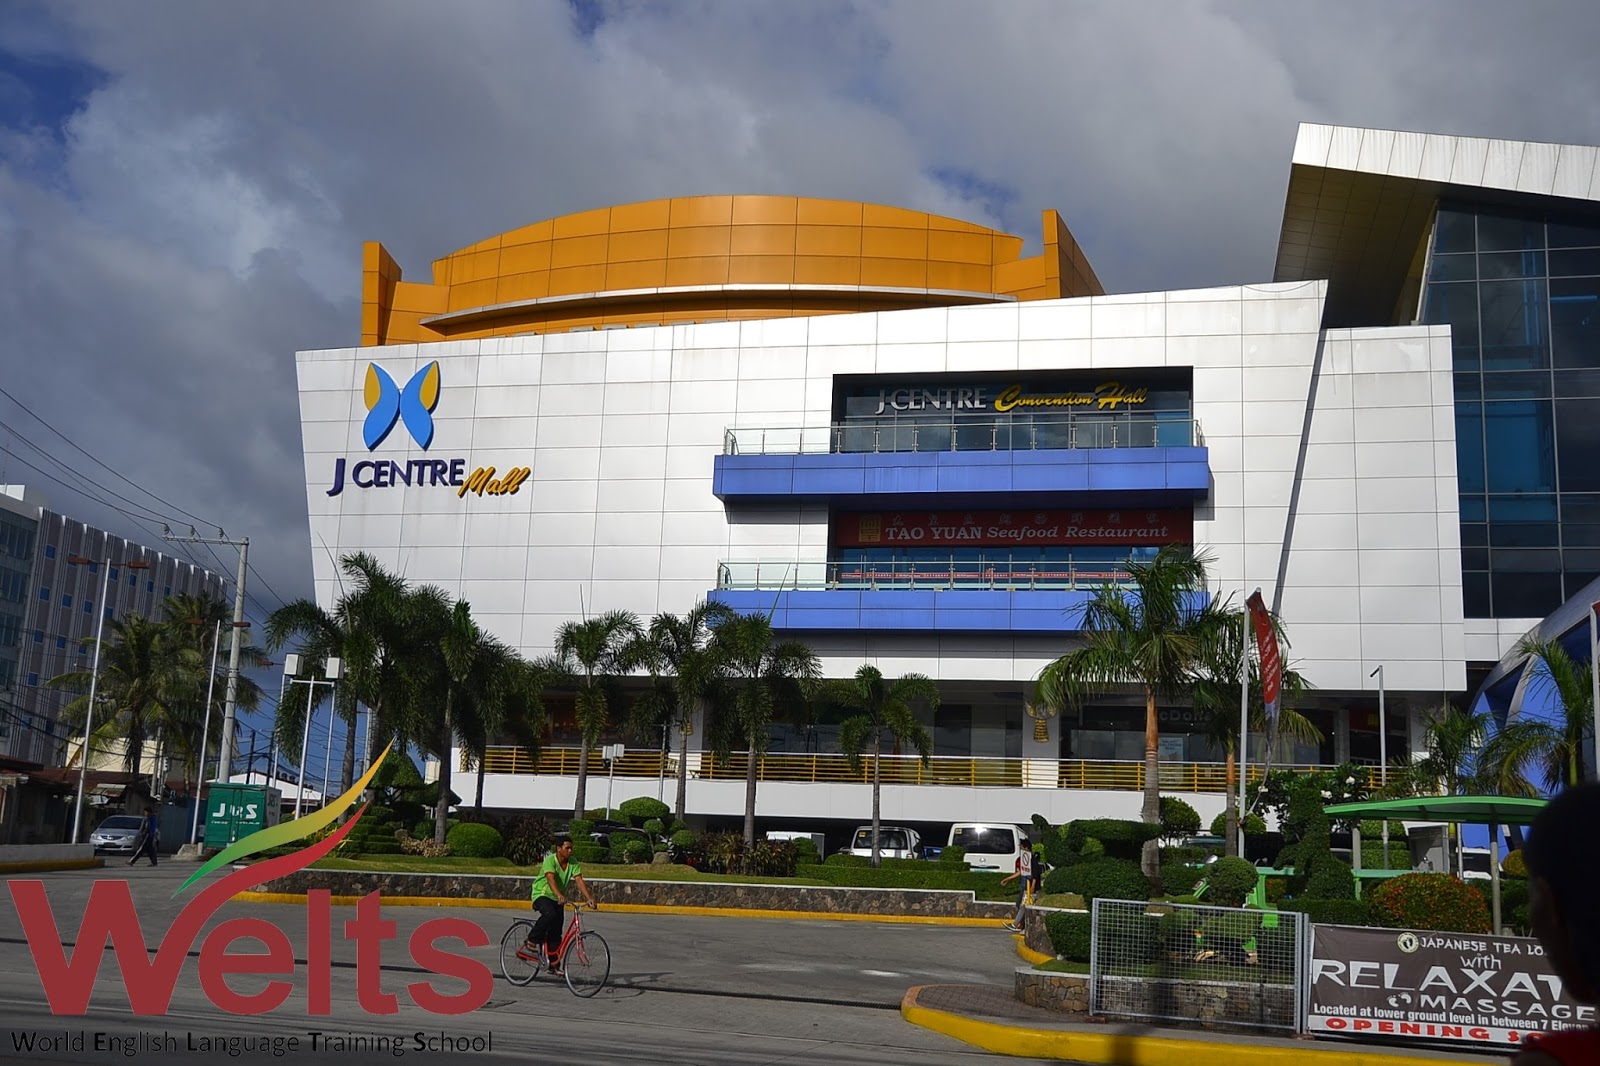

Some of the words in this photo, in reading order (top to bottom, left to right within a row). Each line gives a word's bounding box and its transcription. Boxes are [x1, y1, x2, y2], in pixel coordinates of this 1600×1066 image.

[876, 388, 886, 415] J
[890, 387, 987, 411] CENTRE
[994, 382, 1093, 412] Convention
[1094, 380, 1148, 411] Hall
[326, 458, 346, 497] J
[352, 458, 466, 488] CENTRE
[457, 466, 531, 498] Mall
[885, 526, 925, 541] TAO
[930, 526, 983, 540] YUAN
[986, 526, 1059, 541] Seafood
[1064, 525, 1169, 538] Restaurant
[1420, 936, 1488, 952] JAPANESE
[1492, 941, 1522, 955] TEA
[1526, 943, 1548, 957] LO
[1460, 953, 1502, 970] with
[1312, 958, 1563, 1002] RELAXAT
[1313, 1002, 1357, 1016] Located
[1360, 1006, 1371, 1018] at
[1374, 1006, 1405, 1020] lower
[1408, 1010, 1446, 1023] ground
[1449, 1011, 1475, 1025] level
[1478, 1014, 1489, 1026] in
[1491, 1015, 1538, 1030] between
[1540, 1019, 1549, 1031] 7
[1420, 994, 1596, 1022] MASSAGE
[1325, 1018, 1490, 1040] OPENING
